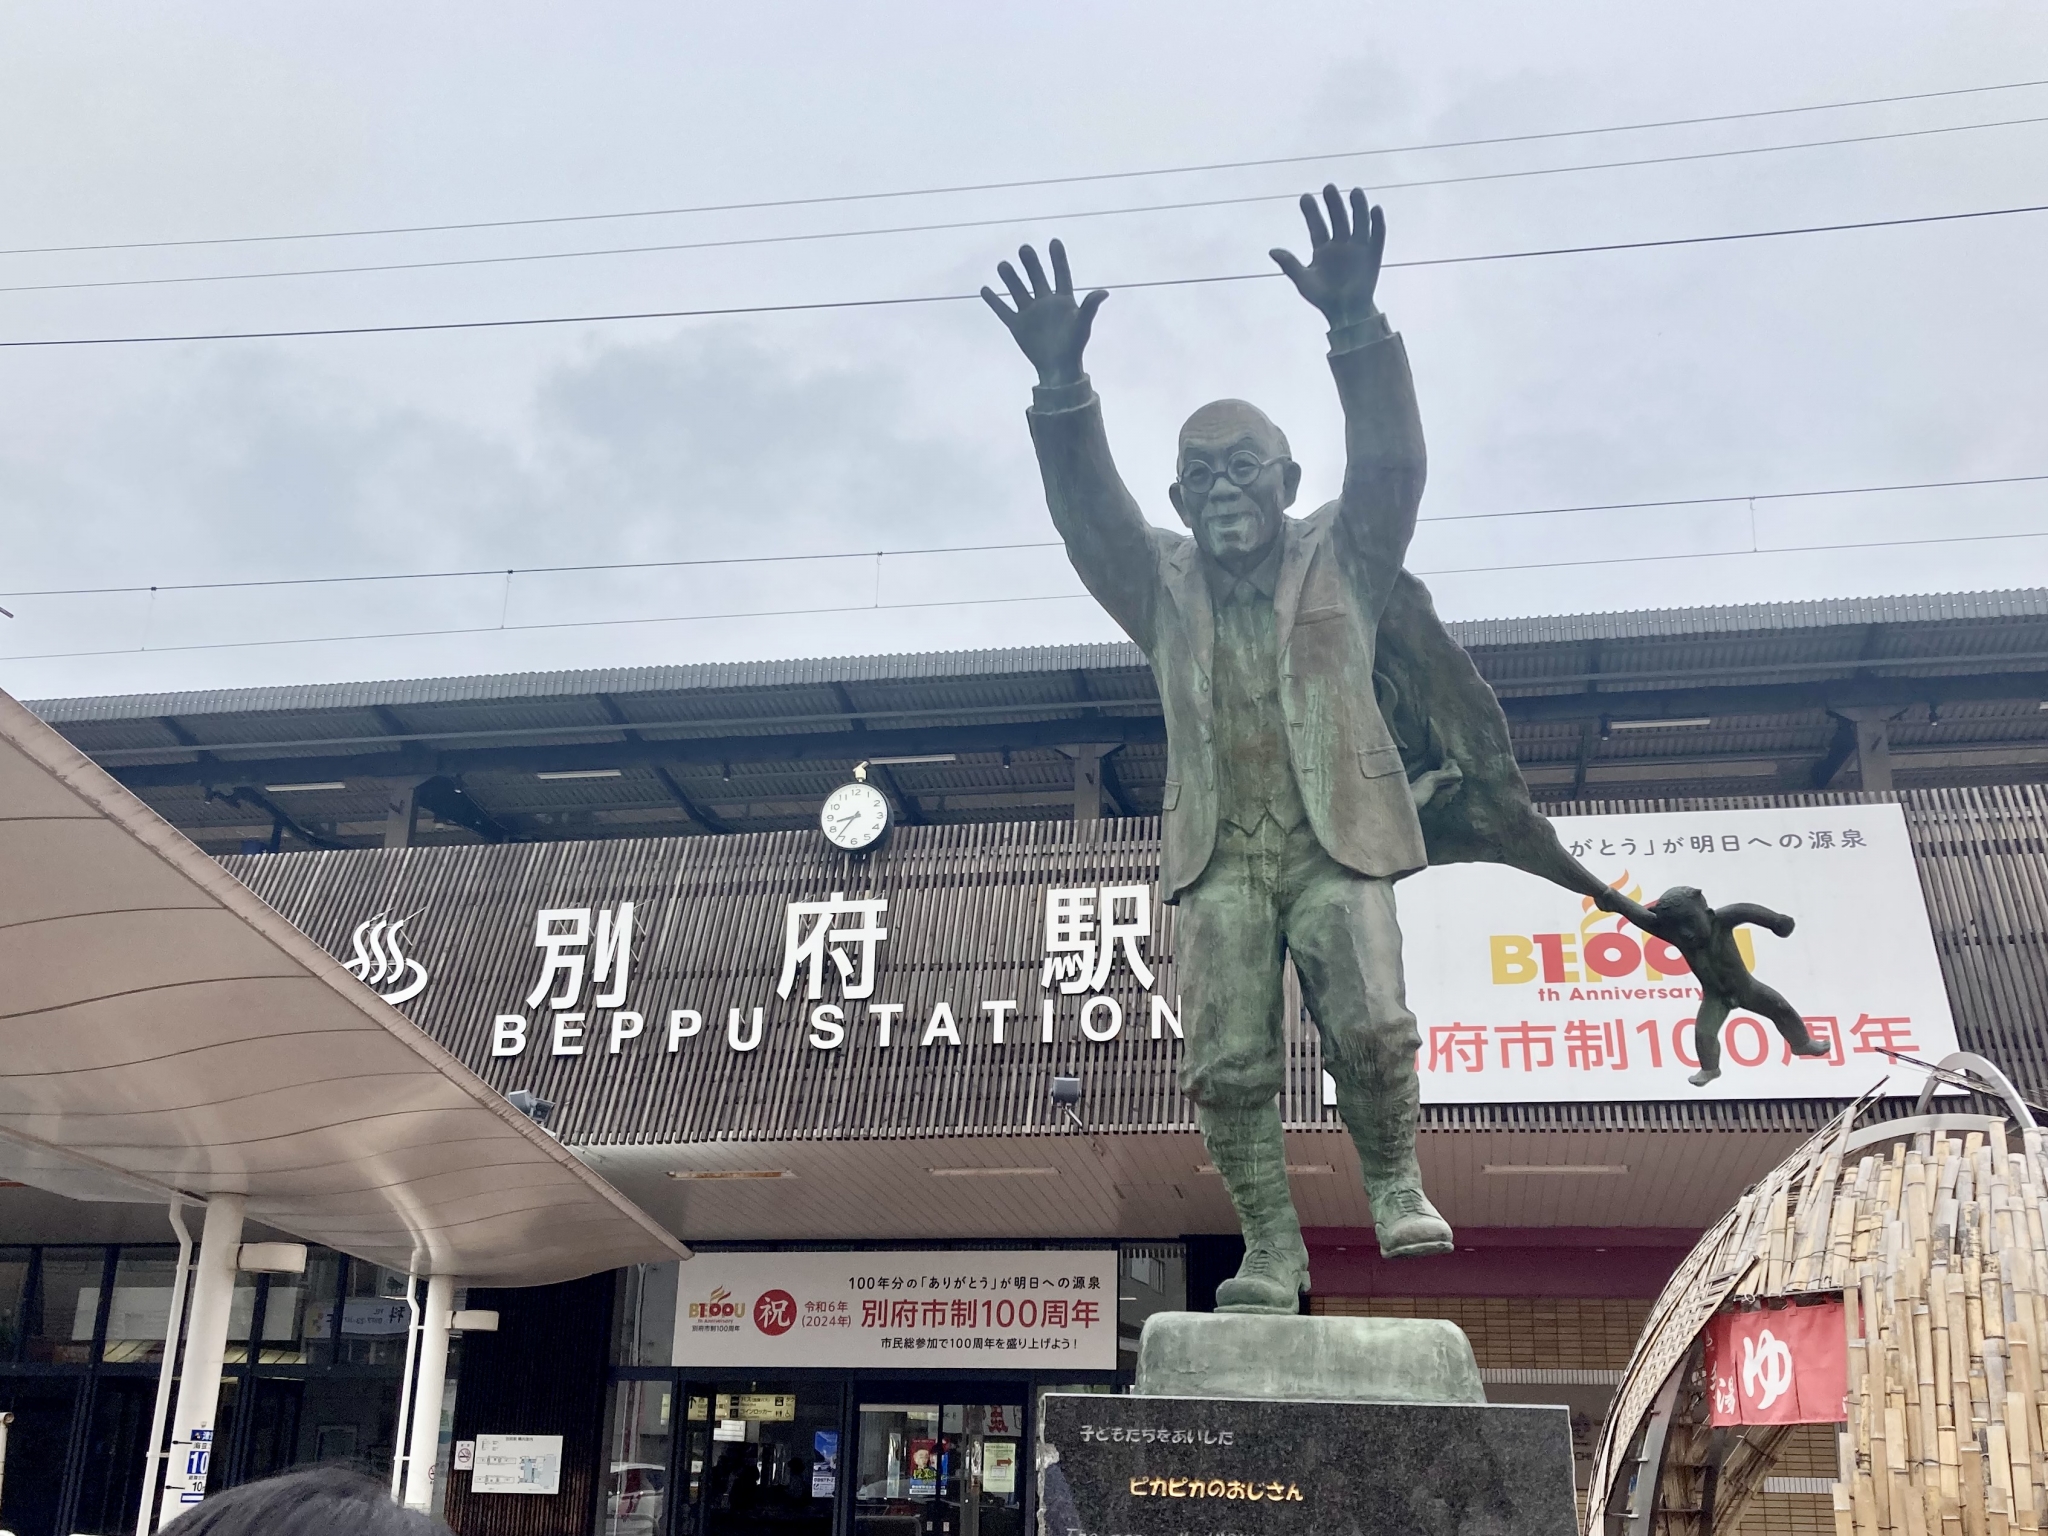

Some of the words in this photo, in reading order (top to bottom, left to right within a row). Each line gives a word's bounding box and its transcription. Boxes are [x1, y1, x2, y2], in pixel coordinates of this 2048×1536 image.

[826, 814, 834, 822] 9
[830, 803, 841, 811] 10
[863, 833, 871, 841] 5
[1569, 828, 1867, 857] がとう」が明日への源泉
[526, 884, 1155, 1010] 別府駅
[1538, 988, 1560, 1001] th
[492, 1007, 763, 1057] BEPPU
[809, 995, 1184, 1050] STATION
[1414, 1013, 1920, 1073] 府市制100周年
[849, 1276, 1101, 1290] 100年分の「ありがとう」が明日への源泉
[758, 1296, 791, 1328] 祝
[804, 1301, 848, 1313] 令和6年
[861, 1299, 1100, 1329] 別府市制100周年
[802, 1315, 851, 1328] (2024年)
[1743, 1329, 1792, 1410] ゆ
[1080, 1424, 1234, 1446] 子どもたちをあいした
[1130, 1476, 1304, 1501] ピカピカのおじさん
